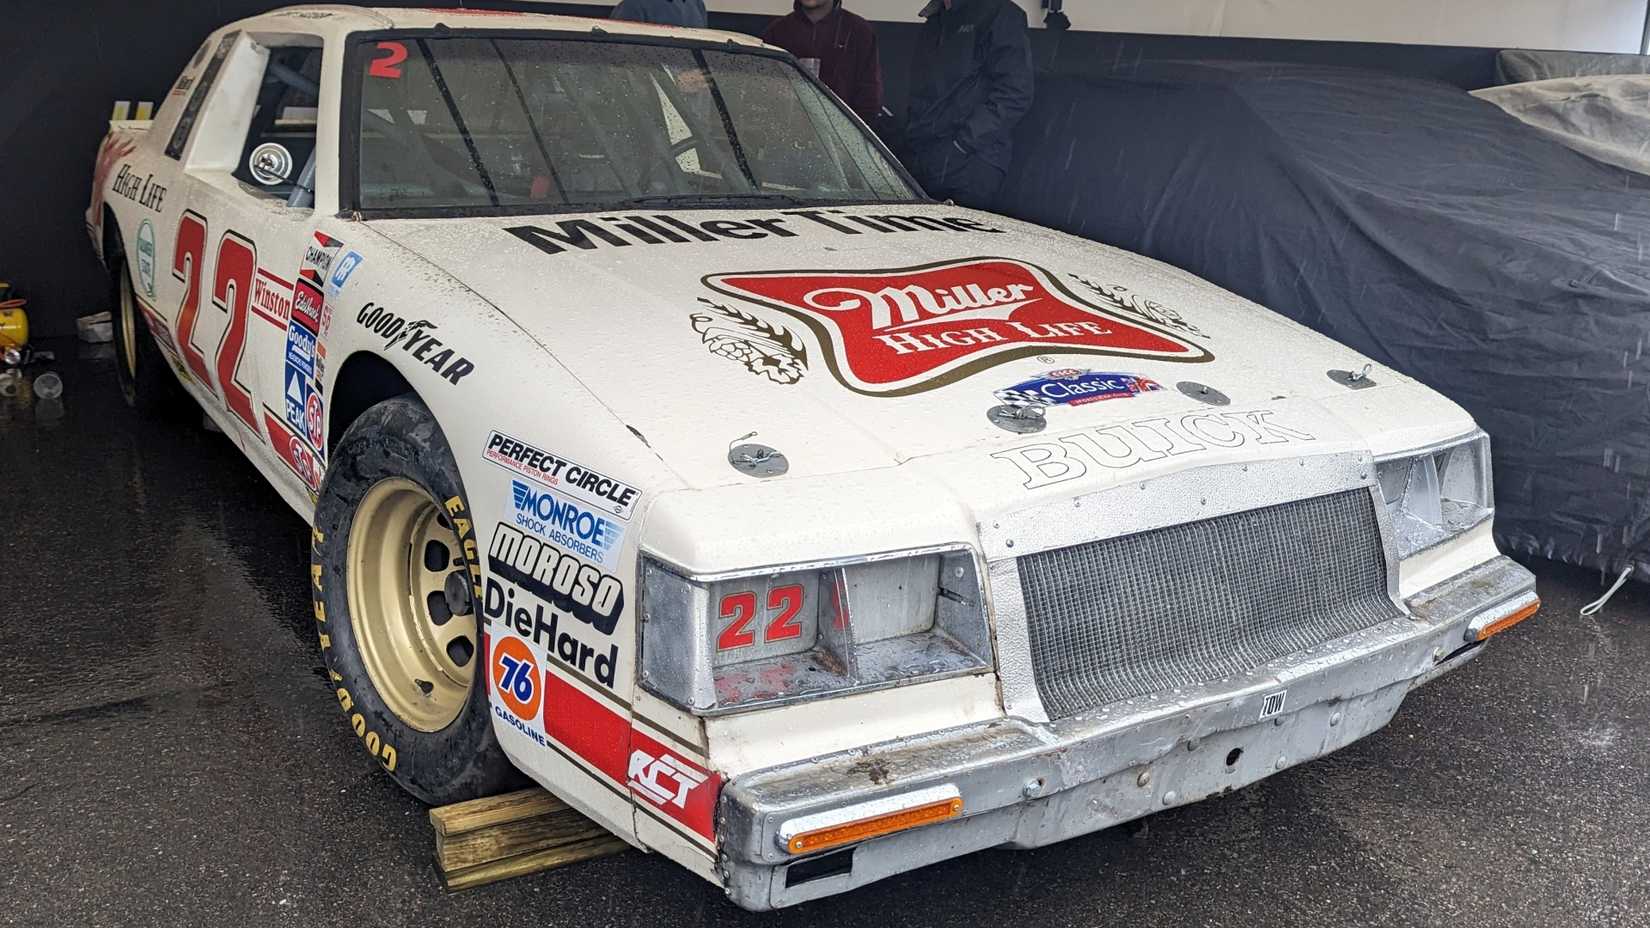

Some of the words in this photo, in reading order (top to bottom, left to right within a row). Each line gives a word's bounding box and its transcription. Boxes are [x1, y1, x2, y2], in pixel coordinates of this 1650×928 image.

[112, 164, 142, 201] HIGH
[139, 174, 167, 213] LIFE
[503, 212, 800, 254] Miller
[782, 209, 1006, 236] Time
[255, 278, 290, 321] Winston
[803, 279, 1035, 331] Miller
[172, 208, 266, 446] 22
[356, 302, 476, 386] GOODYEAR
[873, 324, 1002, 355] HIGH
[1021, 318, 1113, 342] LIFE
[1041, 376, 1125, 397] Classic
[286, 399, 304, 434] PEAK
[486, 450, 522, 471] PERFORMANCE
[523, 464, 542, 479] PISTON
[488, 434, 567, 477] PERFECT
[565, 466, 636, 507] CIRCLE
[992, 409, 1316, 489] BUICK
[516, 513, 547, 536] SHOCK
[549, 528, 604, 563] ABSORBERS
[520, 487, 606, 548] MONROE
[488, 521, 625, 635] MOROSO
[484, 577, 618, 689] DieHard
[716, 584, 805, 651] 22
[498, 653, 534, 702] 76
[494, 706, 546, 747] GASOLINE
[1263, 691, 1286, 716] TOW
